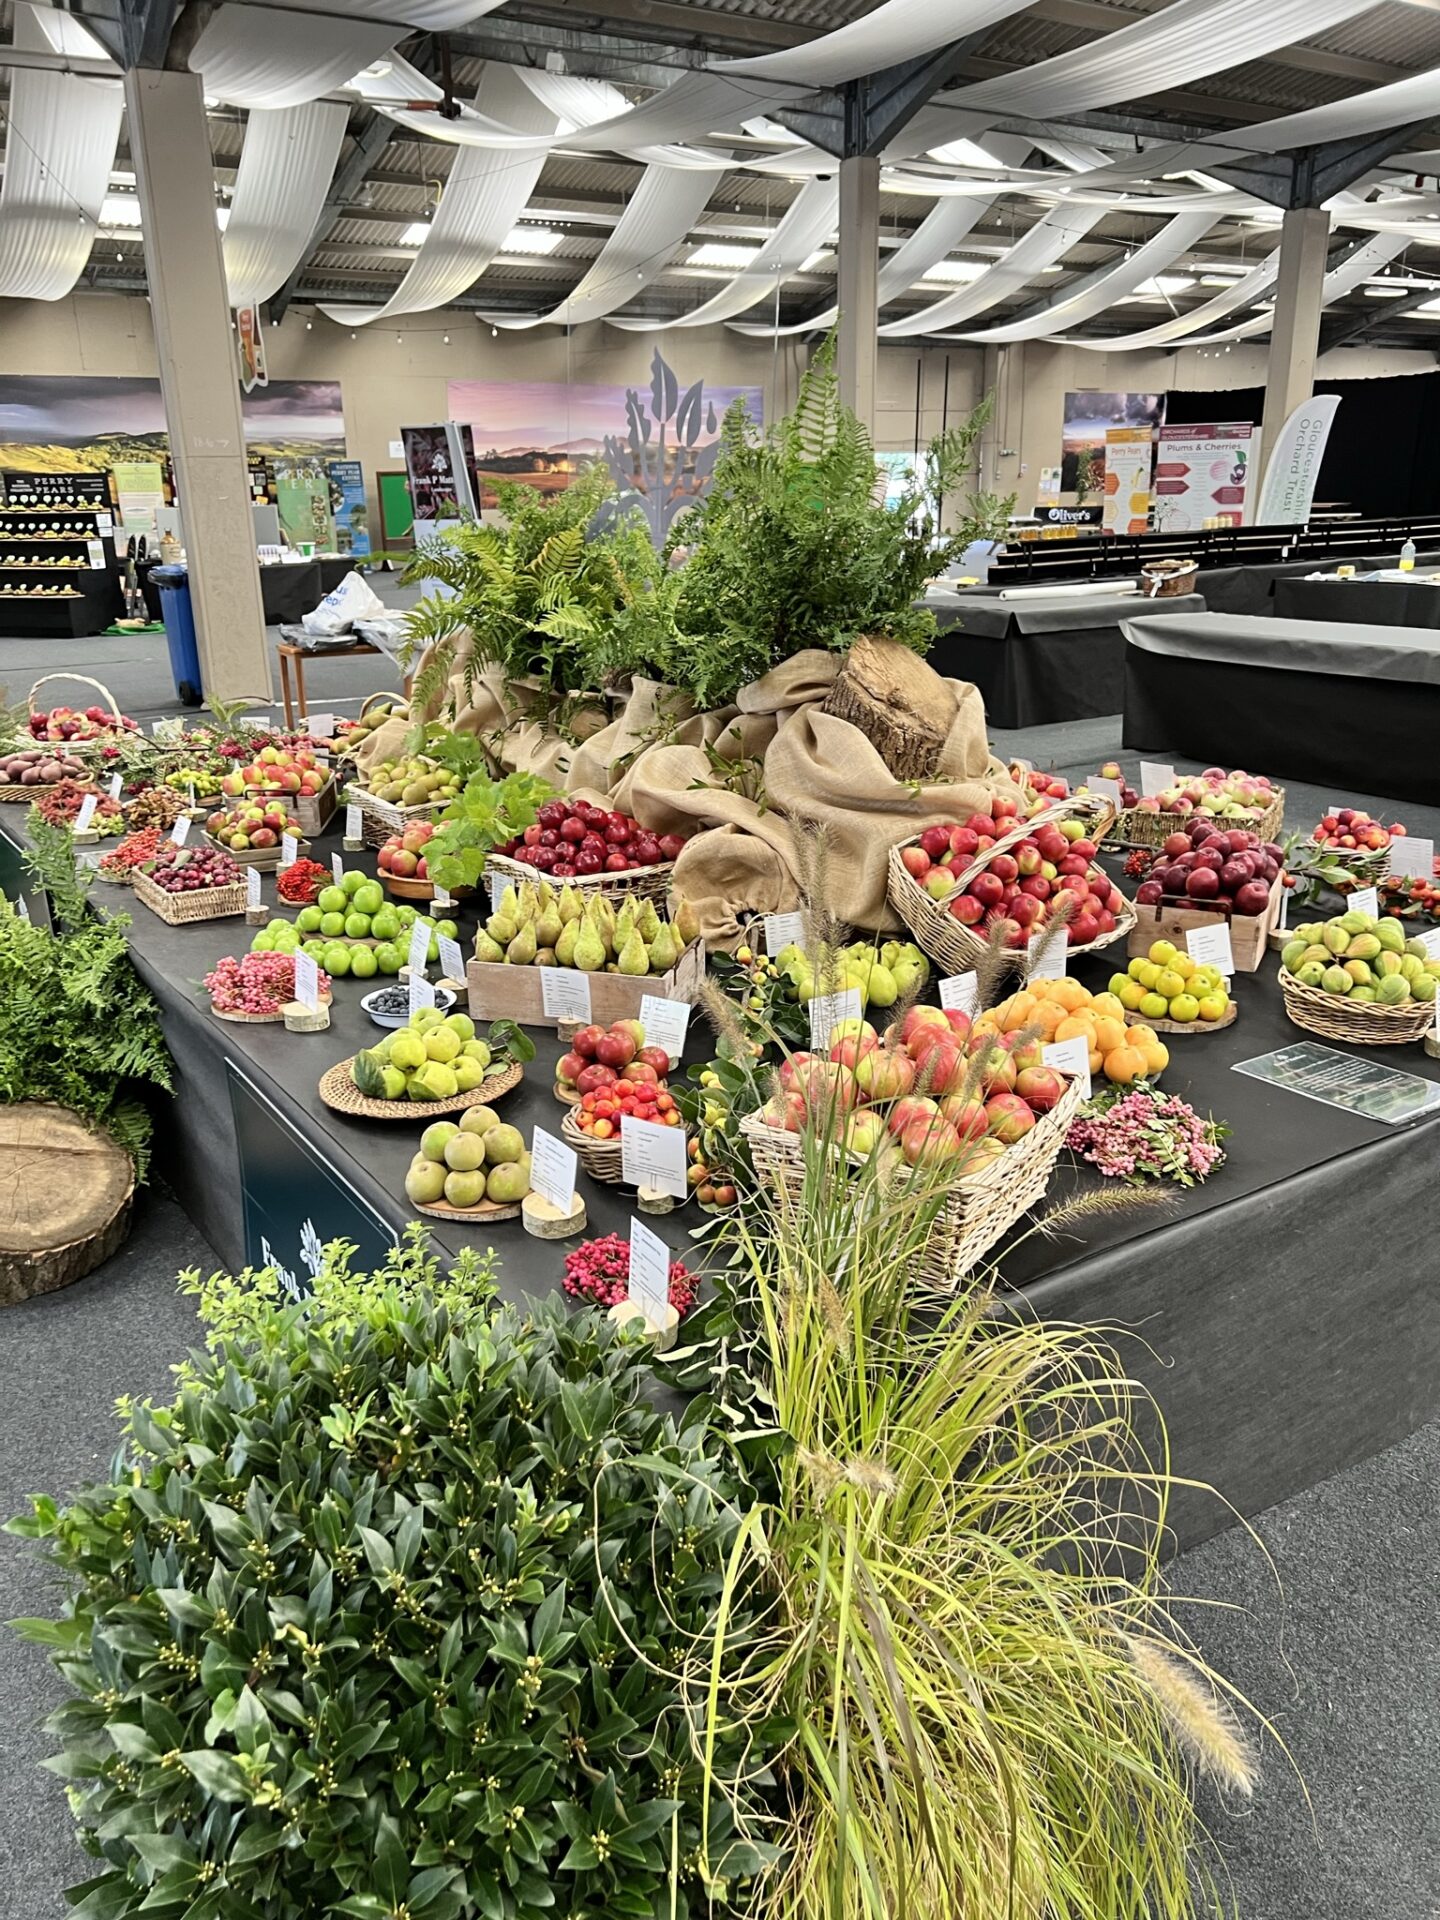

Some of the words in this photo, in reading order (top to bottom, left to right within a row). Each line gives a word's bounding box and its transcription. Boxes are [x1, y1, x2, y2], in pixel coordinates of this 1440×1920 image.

[1167, 444, 1193, 452] Plums
[1195, 443, 1201, 451] &
[1204, 442, 1242, 450] Cherries
[1290, 418, 1310, 475] Orchard
[33, 477, 73, 485] PERRY
[1282, 480, 1298, 511] Trust
[1048, 508, 1091, 521] Oliver's
